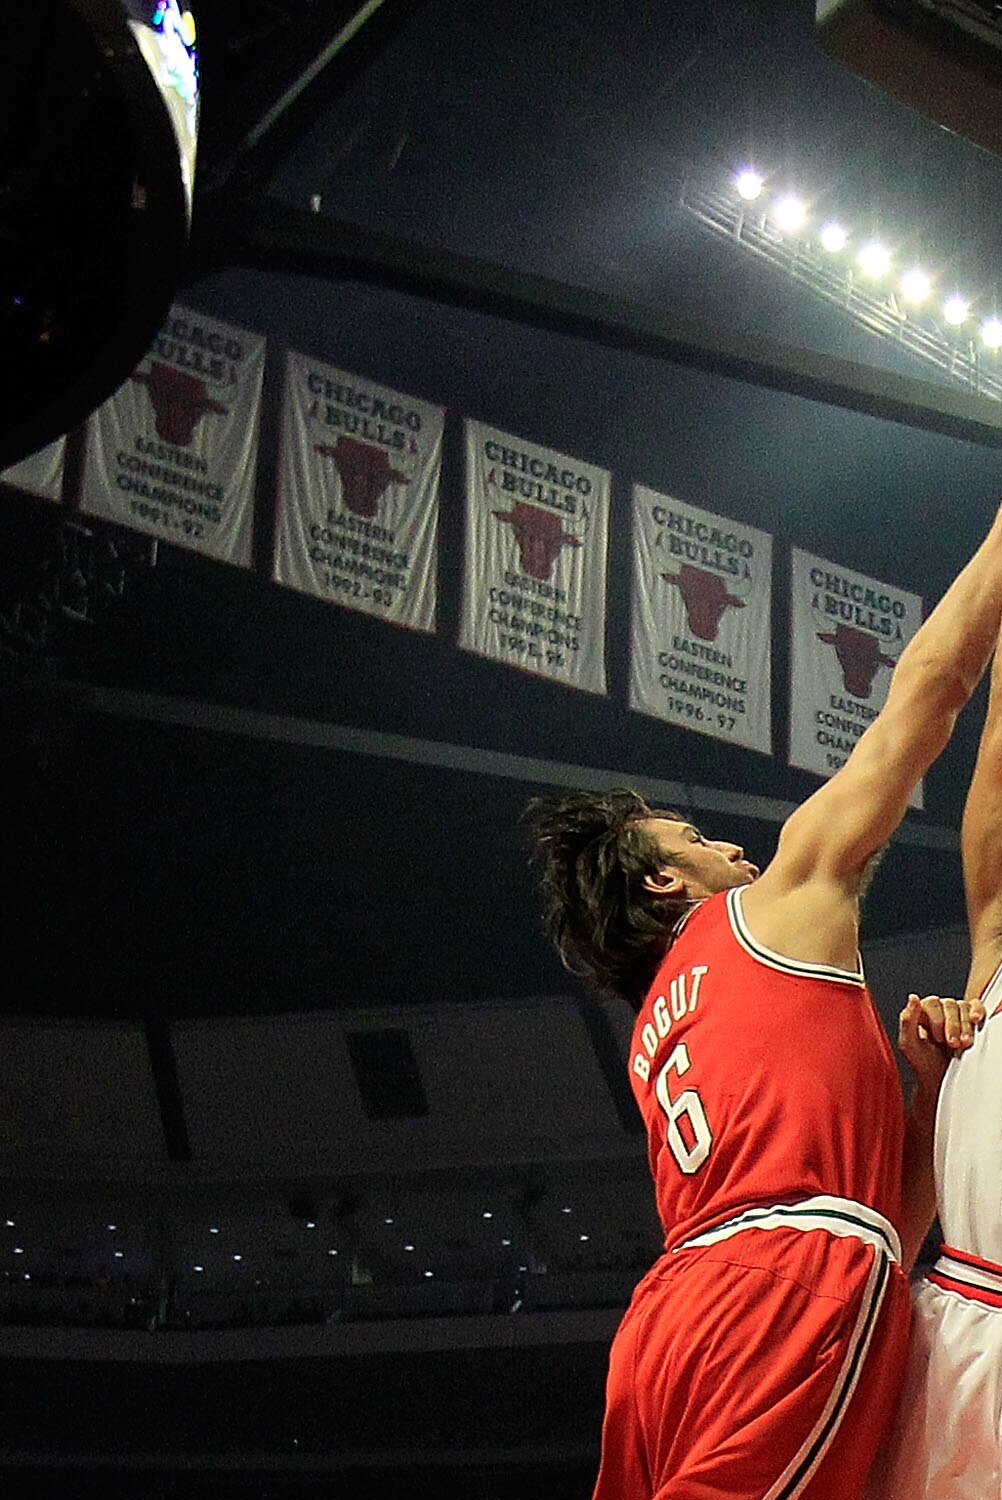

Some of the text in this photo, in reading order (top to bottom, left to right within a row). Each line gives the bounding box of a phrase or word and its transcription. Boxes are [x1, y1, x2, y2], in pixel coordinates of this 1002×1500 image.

[307, 373, 421, 433] CHICAGO
[326, 404, 405, 450] BULLS
[117, 453, 224, 500] CONFERENCE
[484, 441, 593, 497] CHICAGO
[116, 474, 222, 522] CHAMPIONS
[501, 471, 578, 515] BULLS
[310, 525, 409, 567] CONFERENCE
[327, 510, 395, 545] EASTERN
[651, 506, 755, 559] CHICAGO
[309, 546, 407, 591] CHAMPIONS
[669, 534, 740, 576] BULLS
[488, 587, 583, 632] CONFERENCE
[809, 567, 906, 620] CHICAGO
[824, 596, 894, 637] BULLS
[658, 652, 749, 694] CONFERENCE
[673, 636, 734, 669] EASTERN
[659, 674, 746, 715] CHAMPIONS
[633, 965, 709, 1083] BOGUT
[653, 1042, 714, 1175] 6
